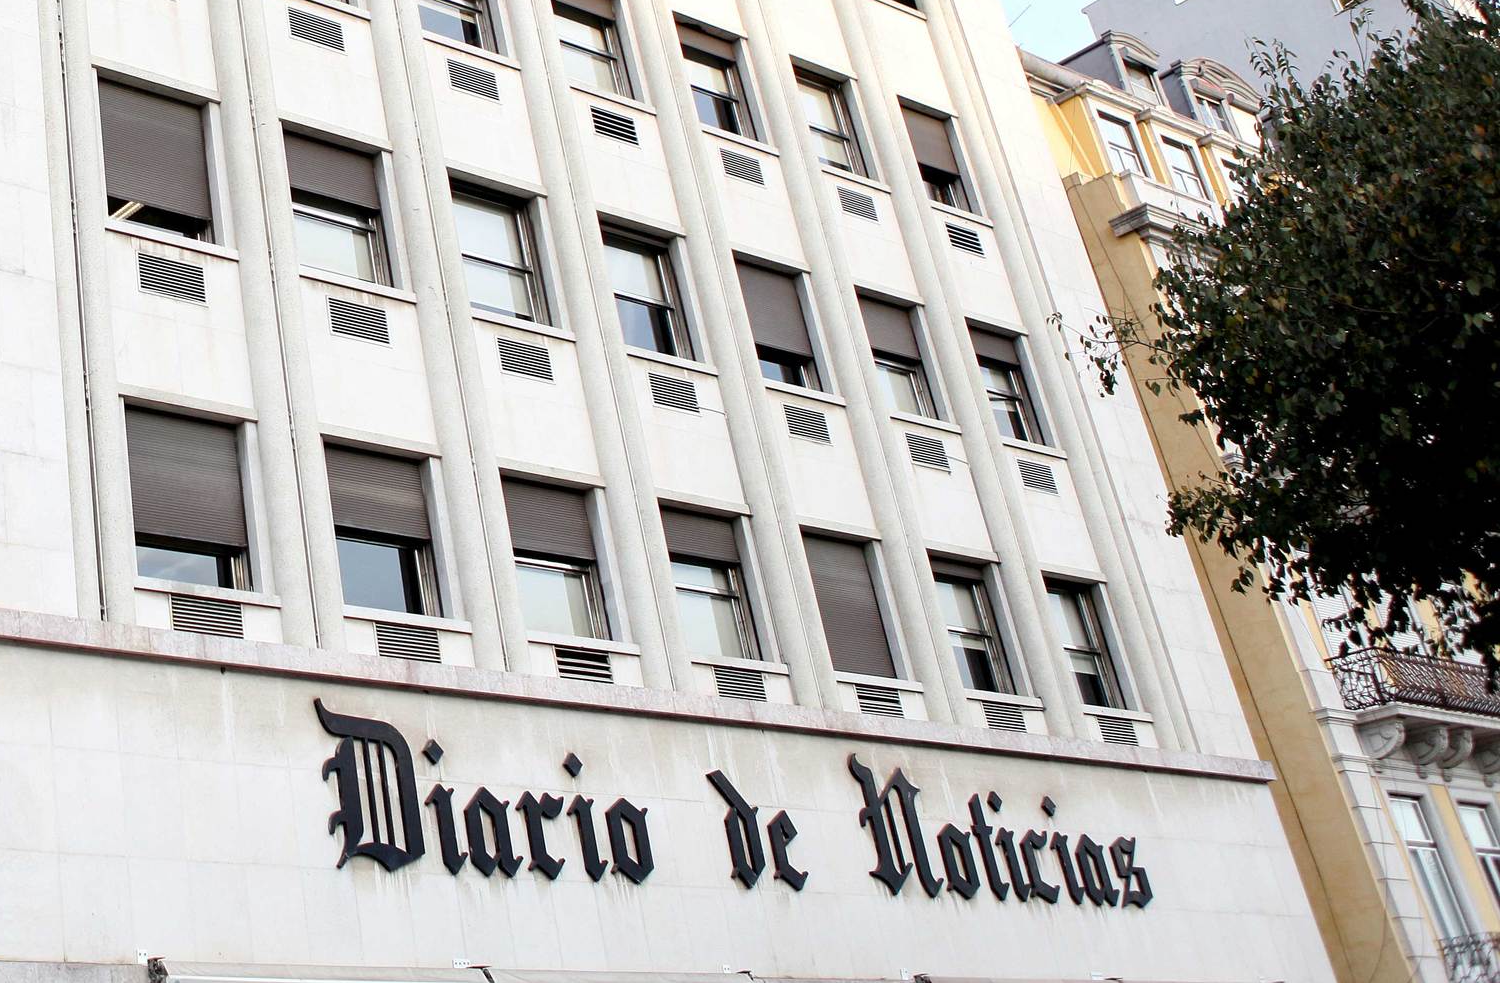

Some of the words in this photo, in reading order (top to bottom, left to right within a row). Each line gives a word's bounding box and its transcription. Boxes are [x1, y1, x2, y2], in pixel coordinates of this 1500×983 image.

[313, 697, 655, 884] Diario
[706, 769, 808, 891] de
[847, 753, 1154, 908] Noticias
